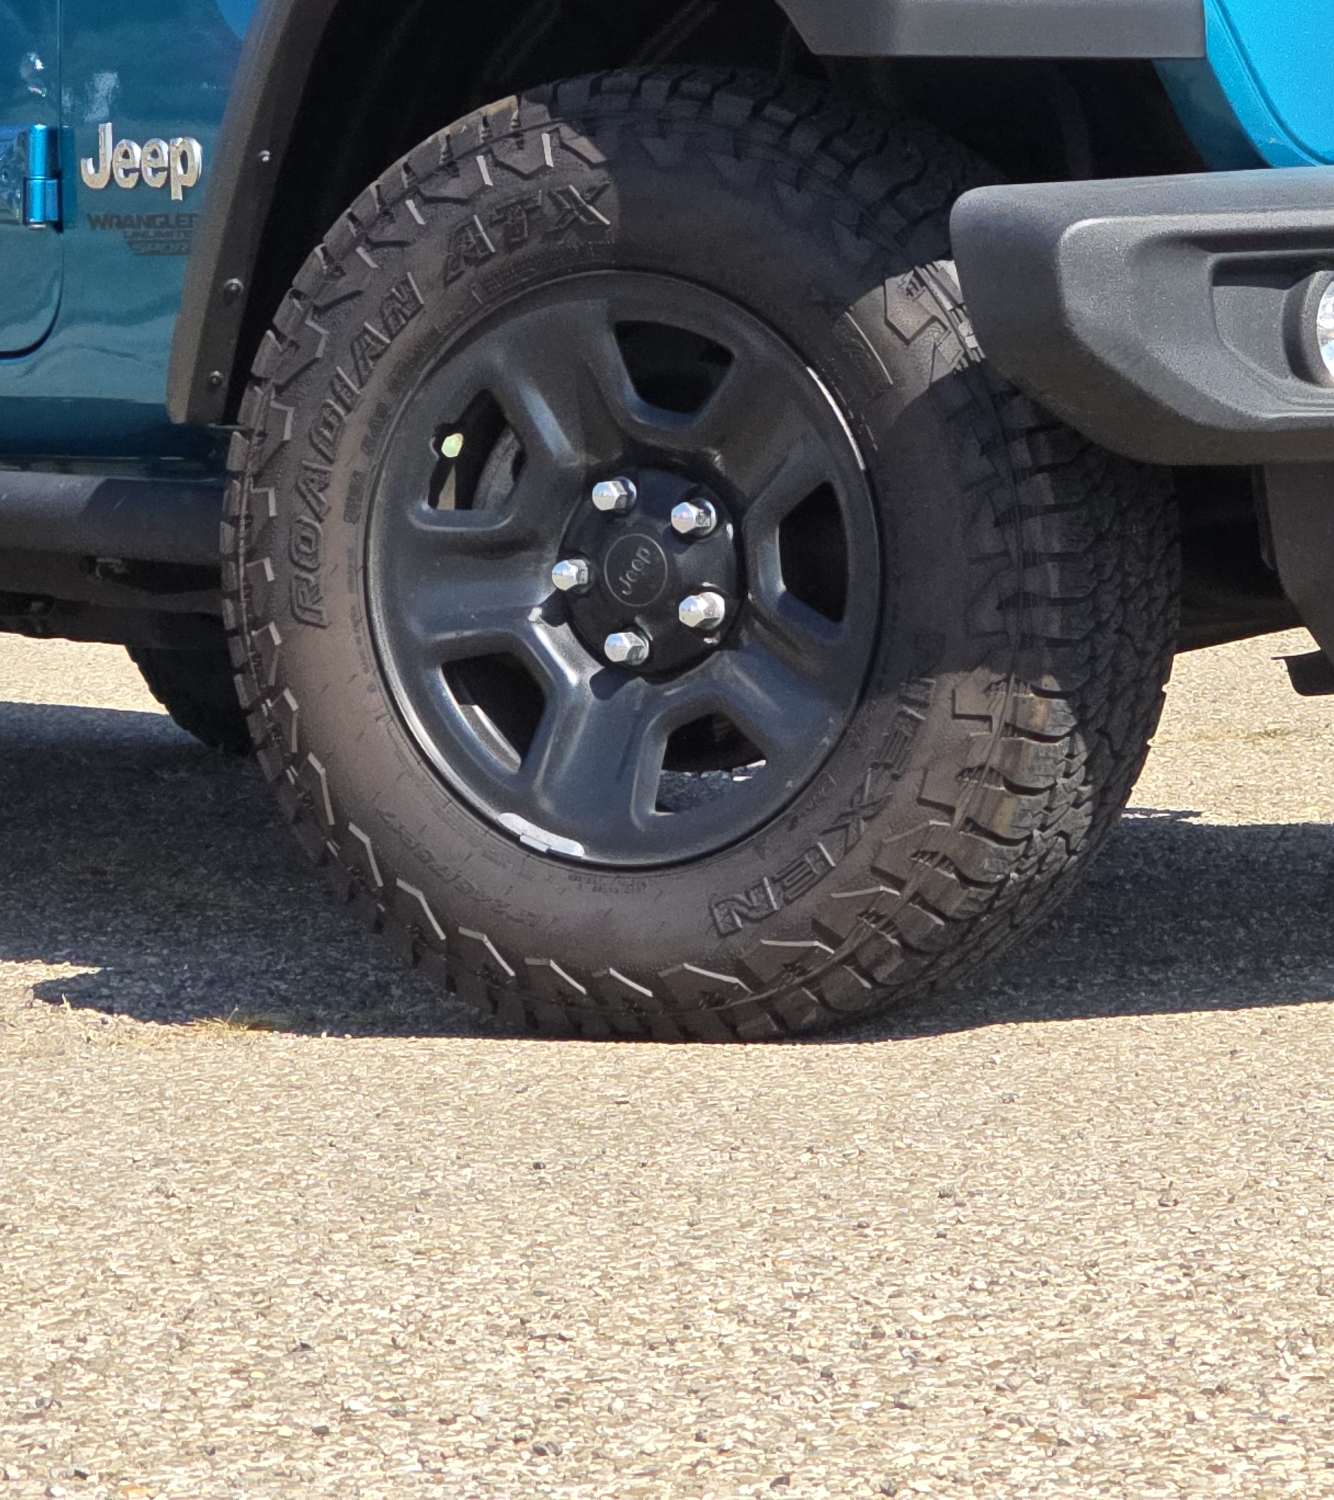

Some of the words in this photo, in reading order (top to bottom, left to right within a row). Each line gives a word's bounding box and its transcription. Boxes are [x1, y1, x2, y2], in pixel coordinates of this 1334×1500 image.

[80, 121, 202, 201] Jeep
[289, 271, 425, 629] ROADIAN
[618, 545, 652, 596] Jeep
[709, 632, 947, 937] NEXEN
